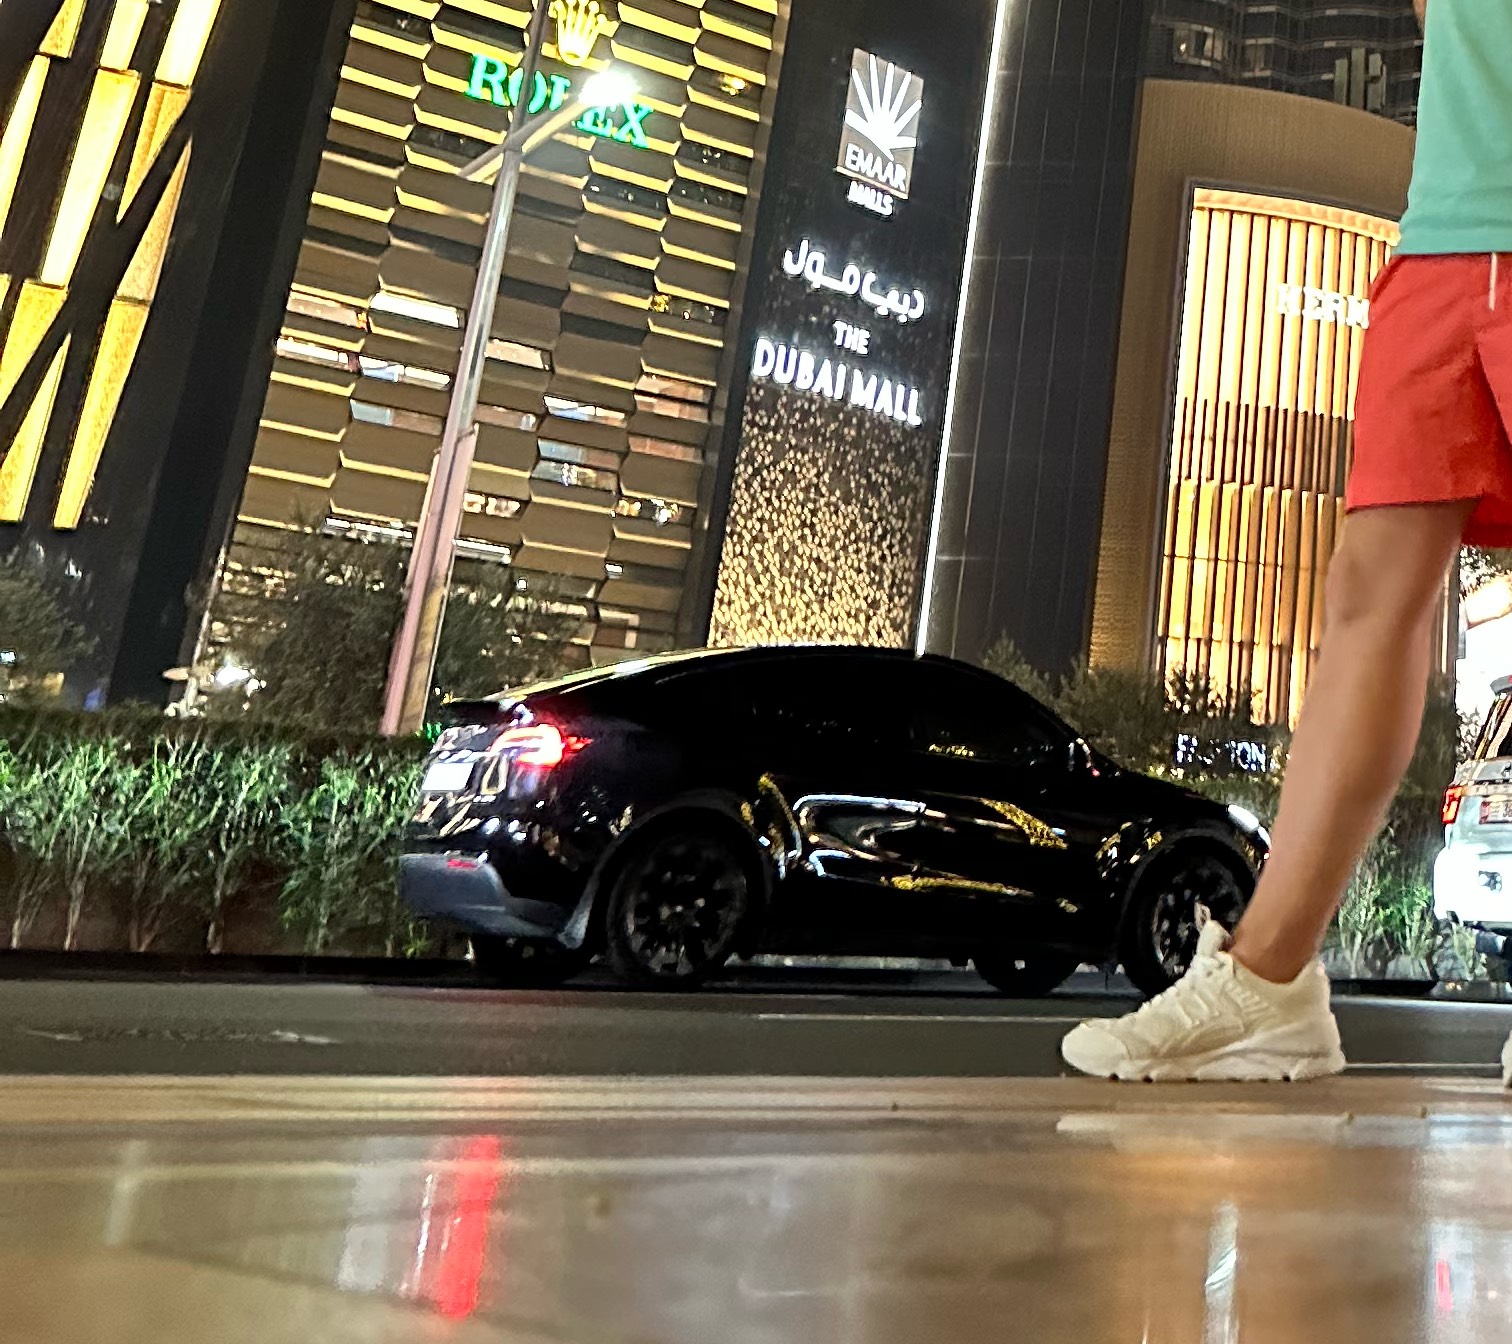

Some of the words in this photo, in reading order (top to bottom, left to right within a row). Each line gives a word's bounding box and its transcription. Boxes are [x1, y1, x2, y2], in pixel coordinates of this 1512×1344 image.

[845, 142, 907, 192] EMAAR
[783, 239, 860, 295] مول
[860, 271, 925, 323] دبي
[833, 320, 870, 355] THE
[752, 337, 847, 400] DUBAI
[850, 368, 922, 426] MALL
